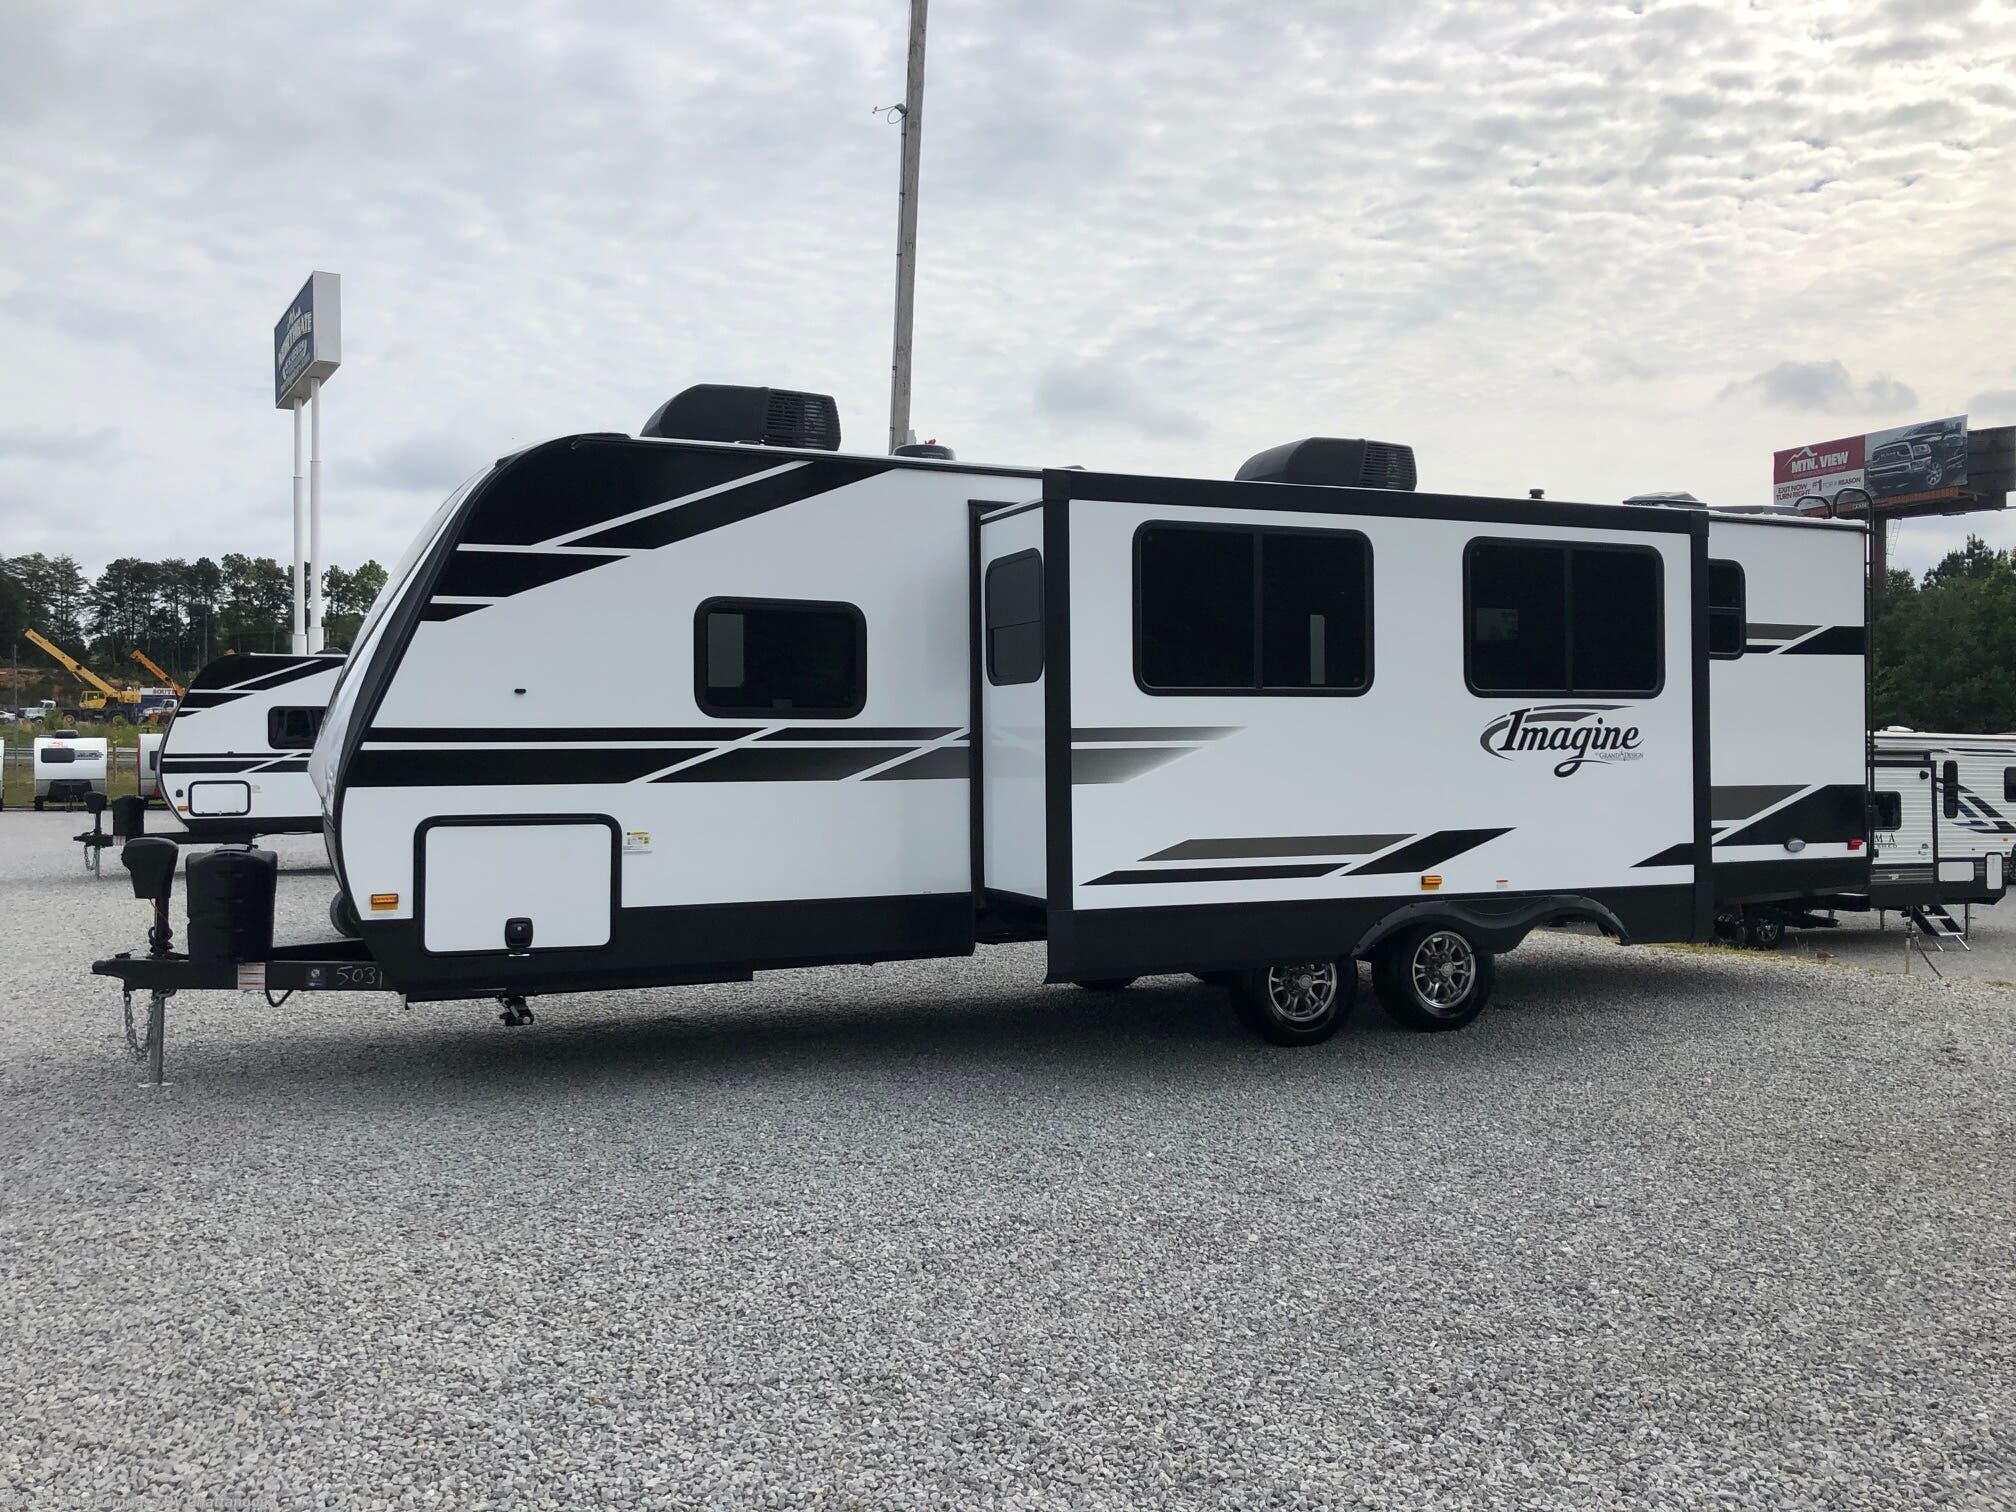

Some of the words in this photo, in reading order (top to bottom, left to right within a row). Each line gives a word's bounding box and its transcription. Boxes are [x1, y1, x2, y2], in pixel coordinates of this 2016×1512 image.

[1792, 458, 1818, 473] MTN.
[1820, 452, 1849, 467] VIEW
[1778, 485, 1791, 494] EXIT
[1792, 483, 1808, 492] NOW
[1838, 476, 1861, 486] REASON
[1776, 493, 1792, 501] TURN
[1497, 707, 1645, 778] Imagine
[336, 965, 383, 988] 5031
